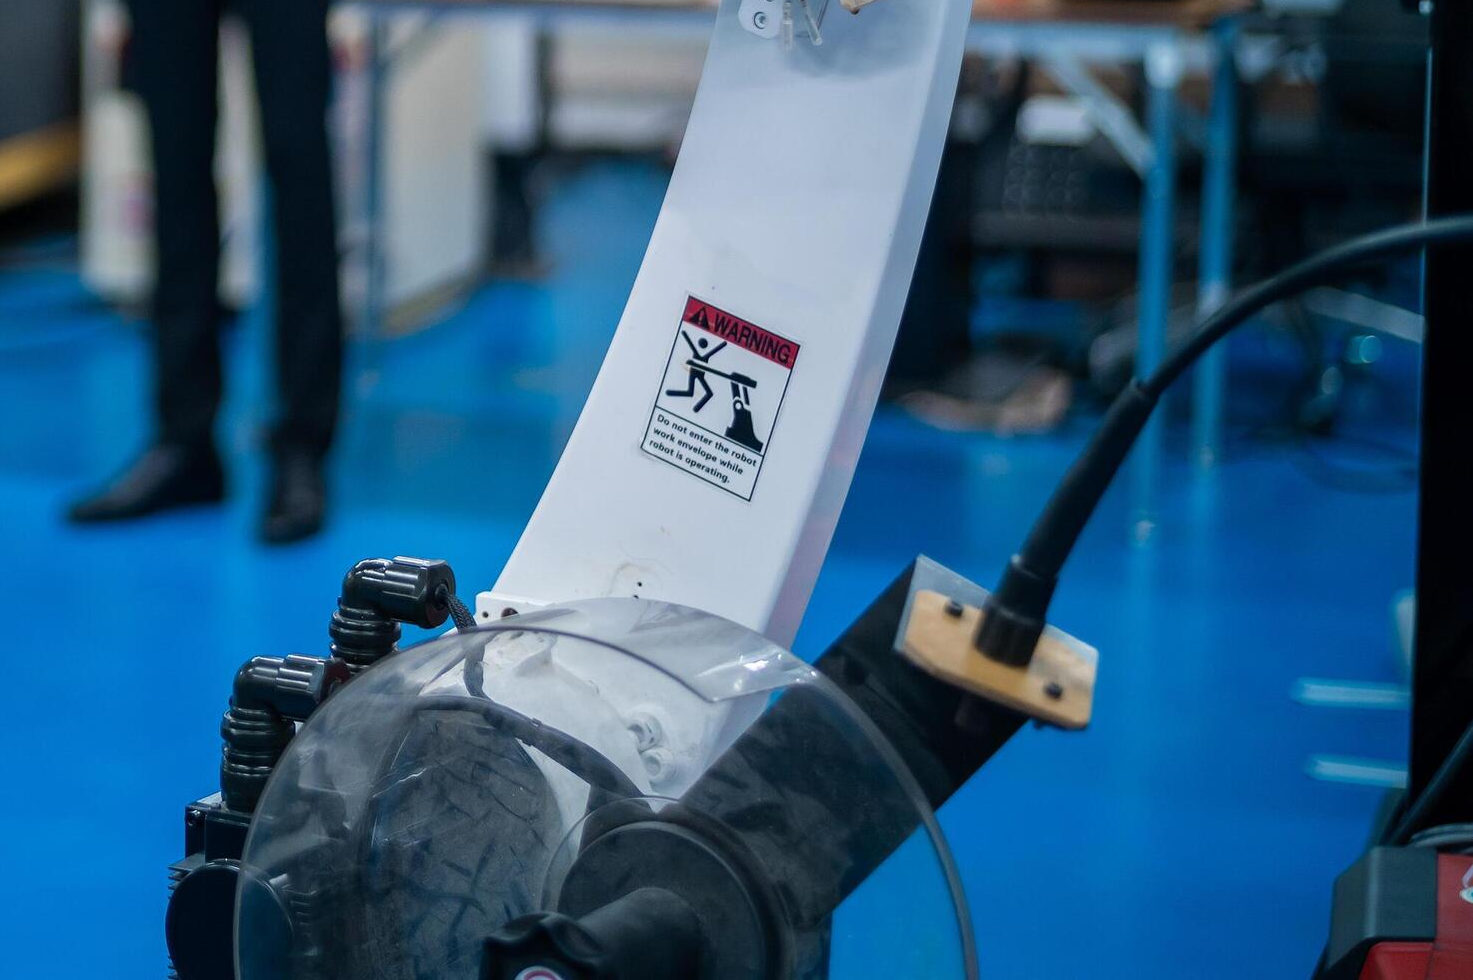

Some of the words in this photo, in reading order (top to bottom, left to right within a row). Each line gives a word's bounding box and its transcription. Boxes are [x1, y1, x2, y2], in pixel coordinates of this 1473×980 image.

[714, 313, 792, 365] WARNING
[649, 440, 674, 456] robot
[676, 450, 683, 460] is
[685, 457, 730, 484] operating.
[653, 428, 675, 442] work
[677, 439, 717, 461] envelope
[719, 458, 744, 475] while
[657, 414, 670, 426] Do
[671, 422, 687, 434] not
[689, 430, 713, 445] enter
[714, 440, 729, 453] the
[731, 451, 757, 466] robot
